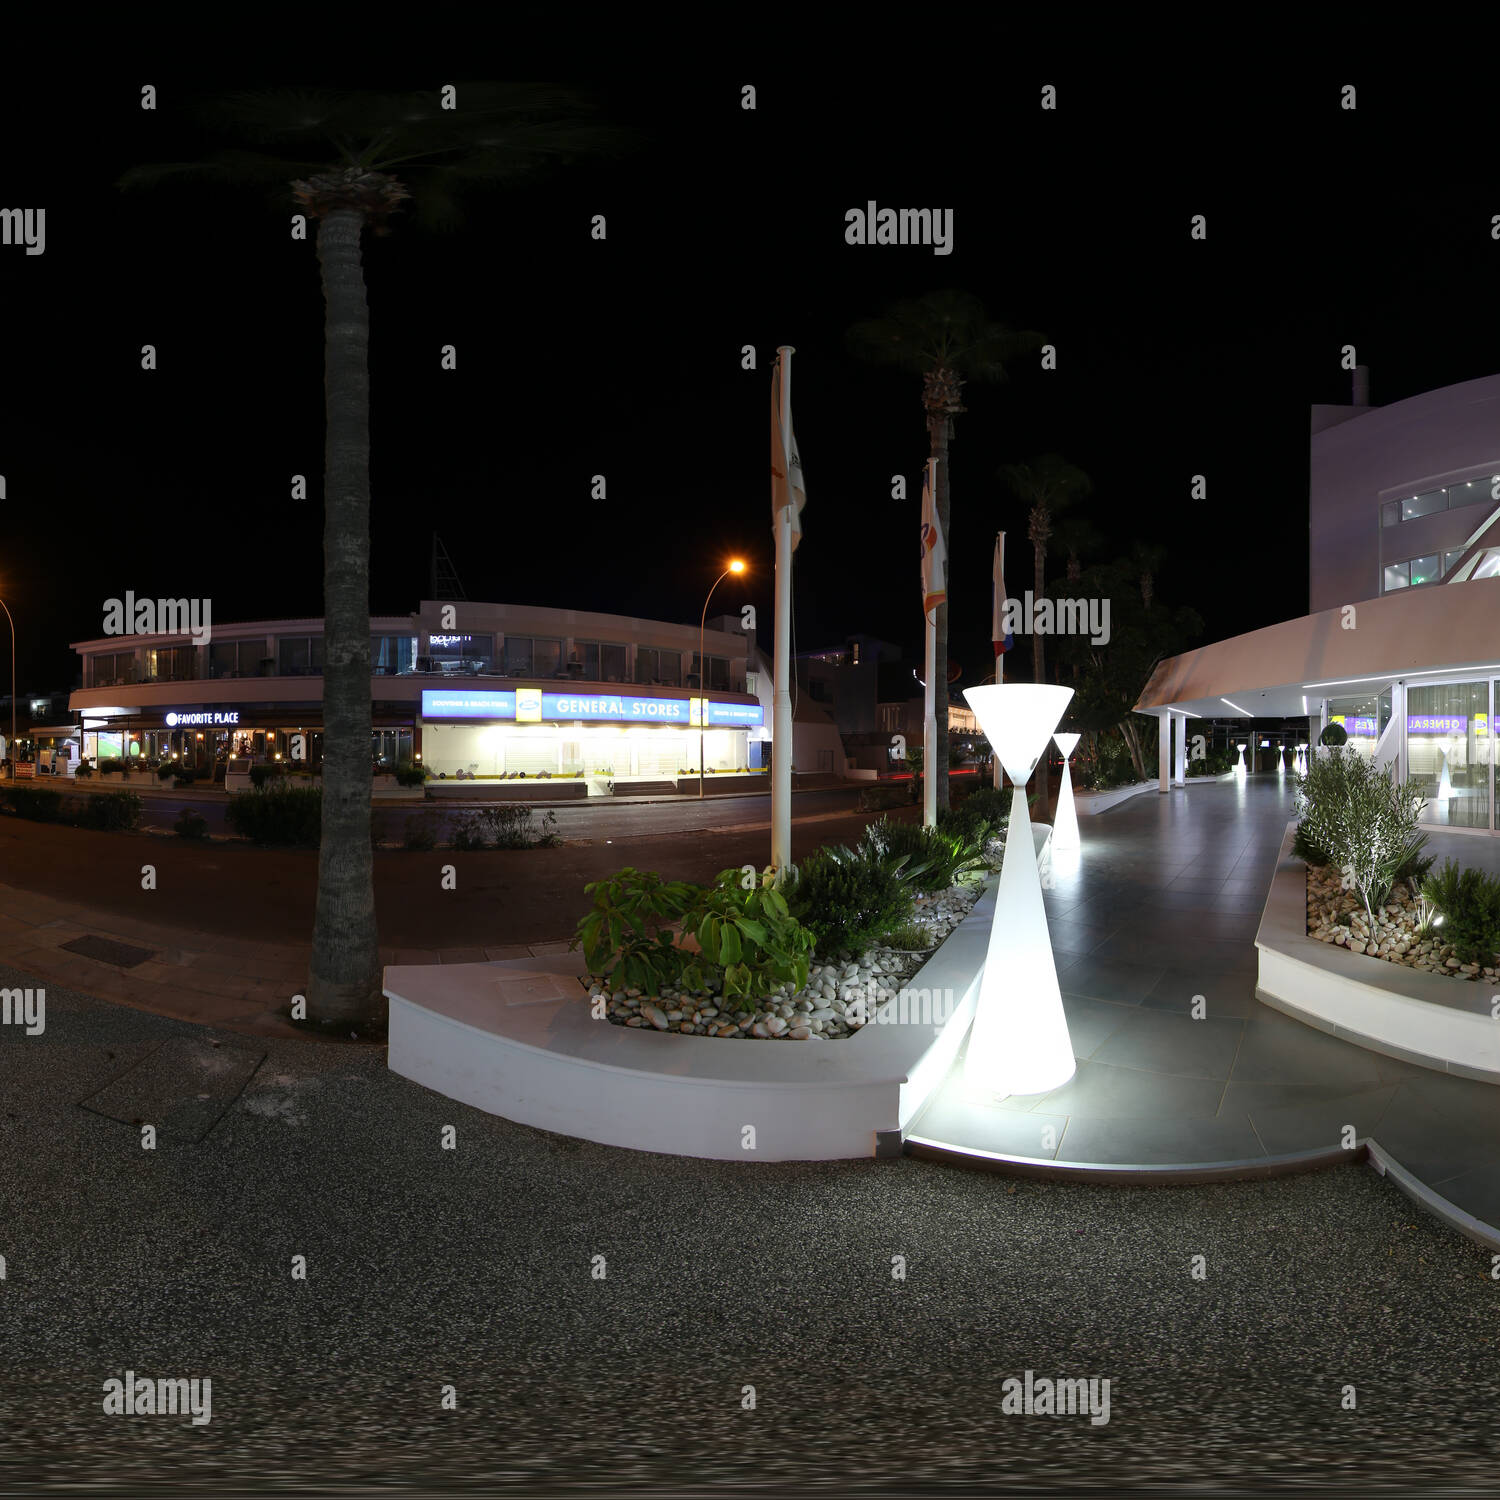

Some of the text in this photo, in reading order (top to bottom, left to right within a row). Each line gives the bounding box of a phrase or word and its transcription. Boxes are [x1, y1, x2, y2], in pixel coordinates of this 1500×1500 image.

[557, 699, 625, 714] GENERAL
[632, 702, 681, 717] STORES
[177, 711, 239, 725] FAVORITE PLACE
